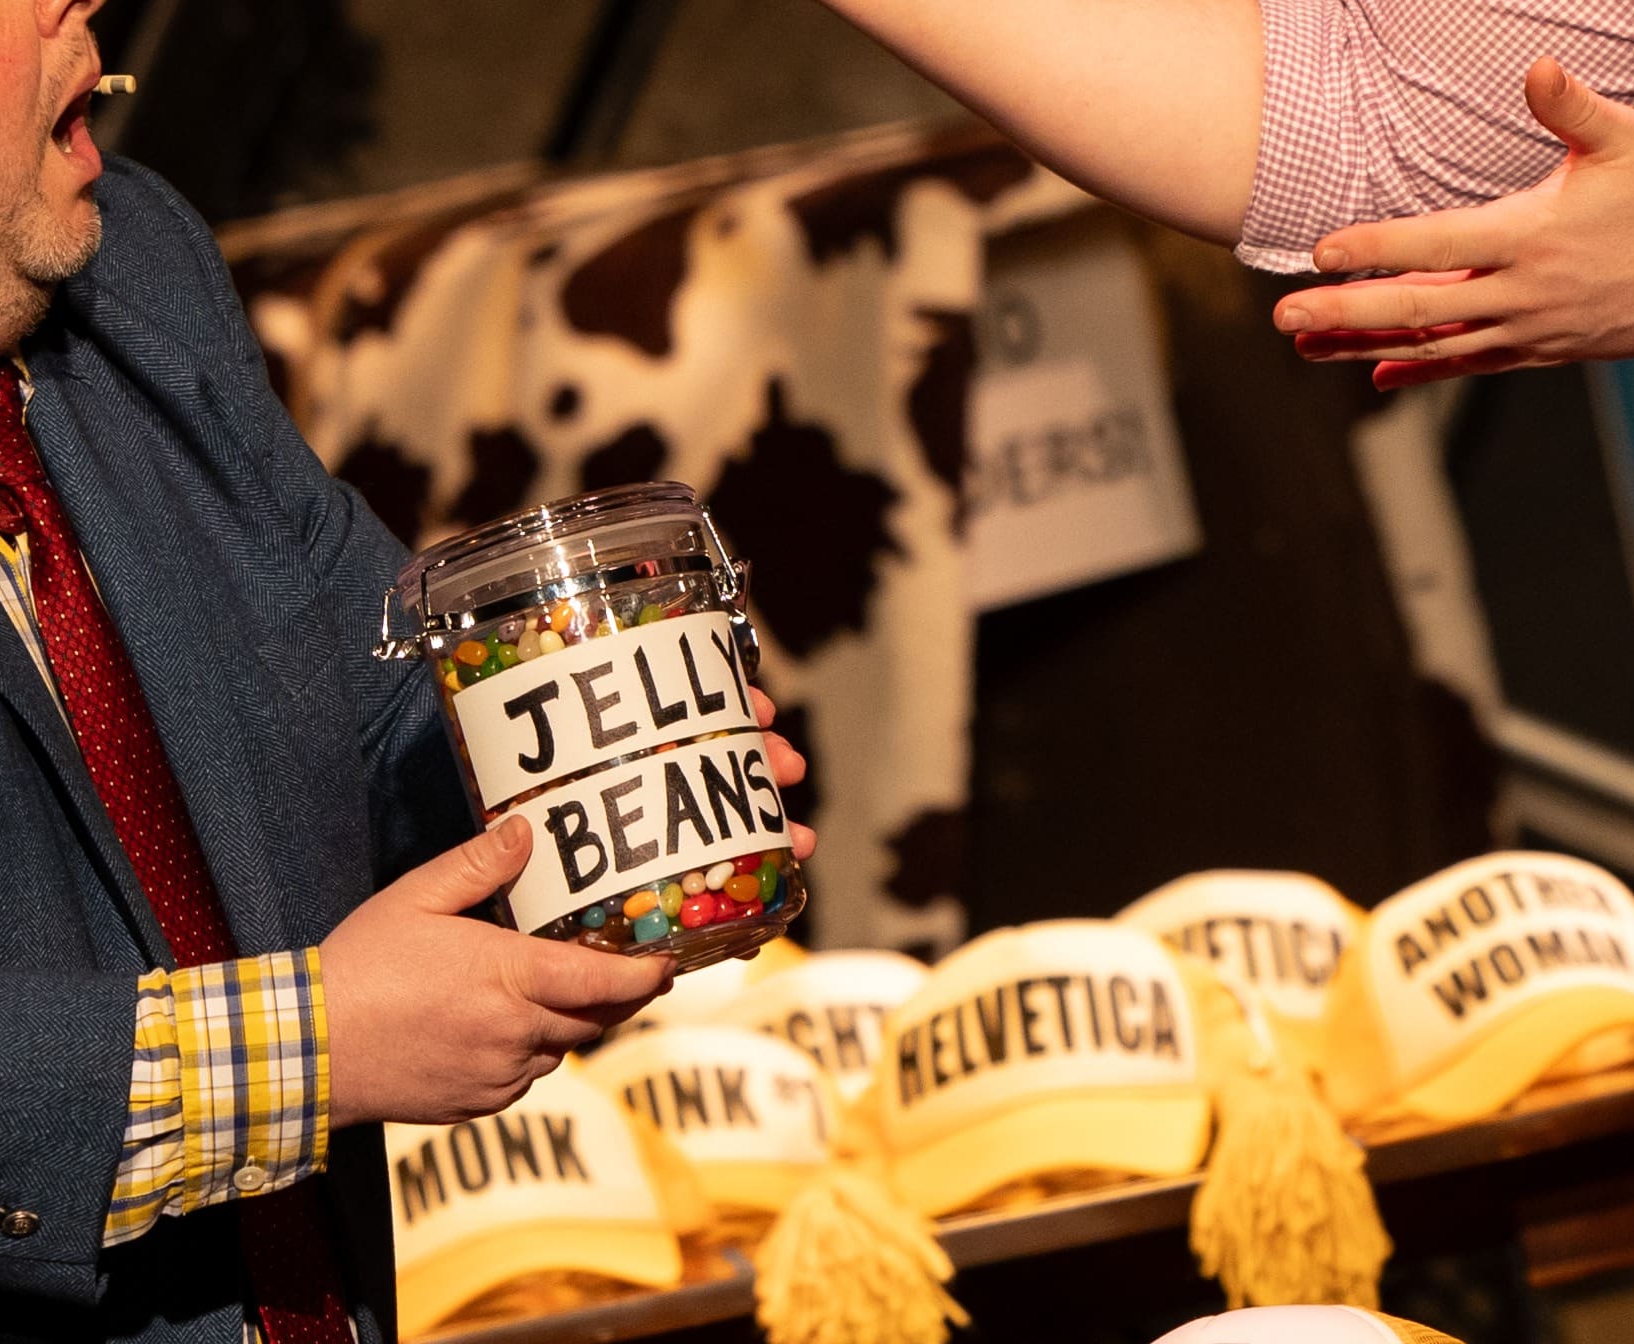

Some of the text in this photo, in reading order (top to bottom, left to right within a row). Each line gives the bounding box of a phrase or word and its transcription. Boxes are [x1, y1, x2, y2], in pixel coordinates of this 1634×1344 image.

[503, 607, 752, 775] JELLY
[544, 747, 786, 895] BEANS
[896, 973, 1184, 1111] HELVETICA
[395, 1112, 590, 1224] MONK
